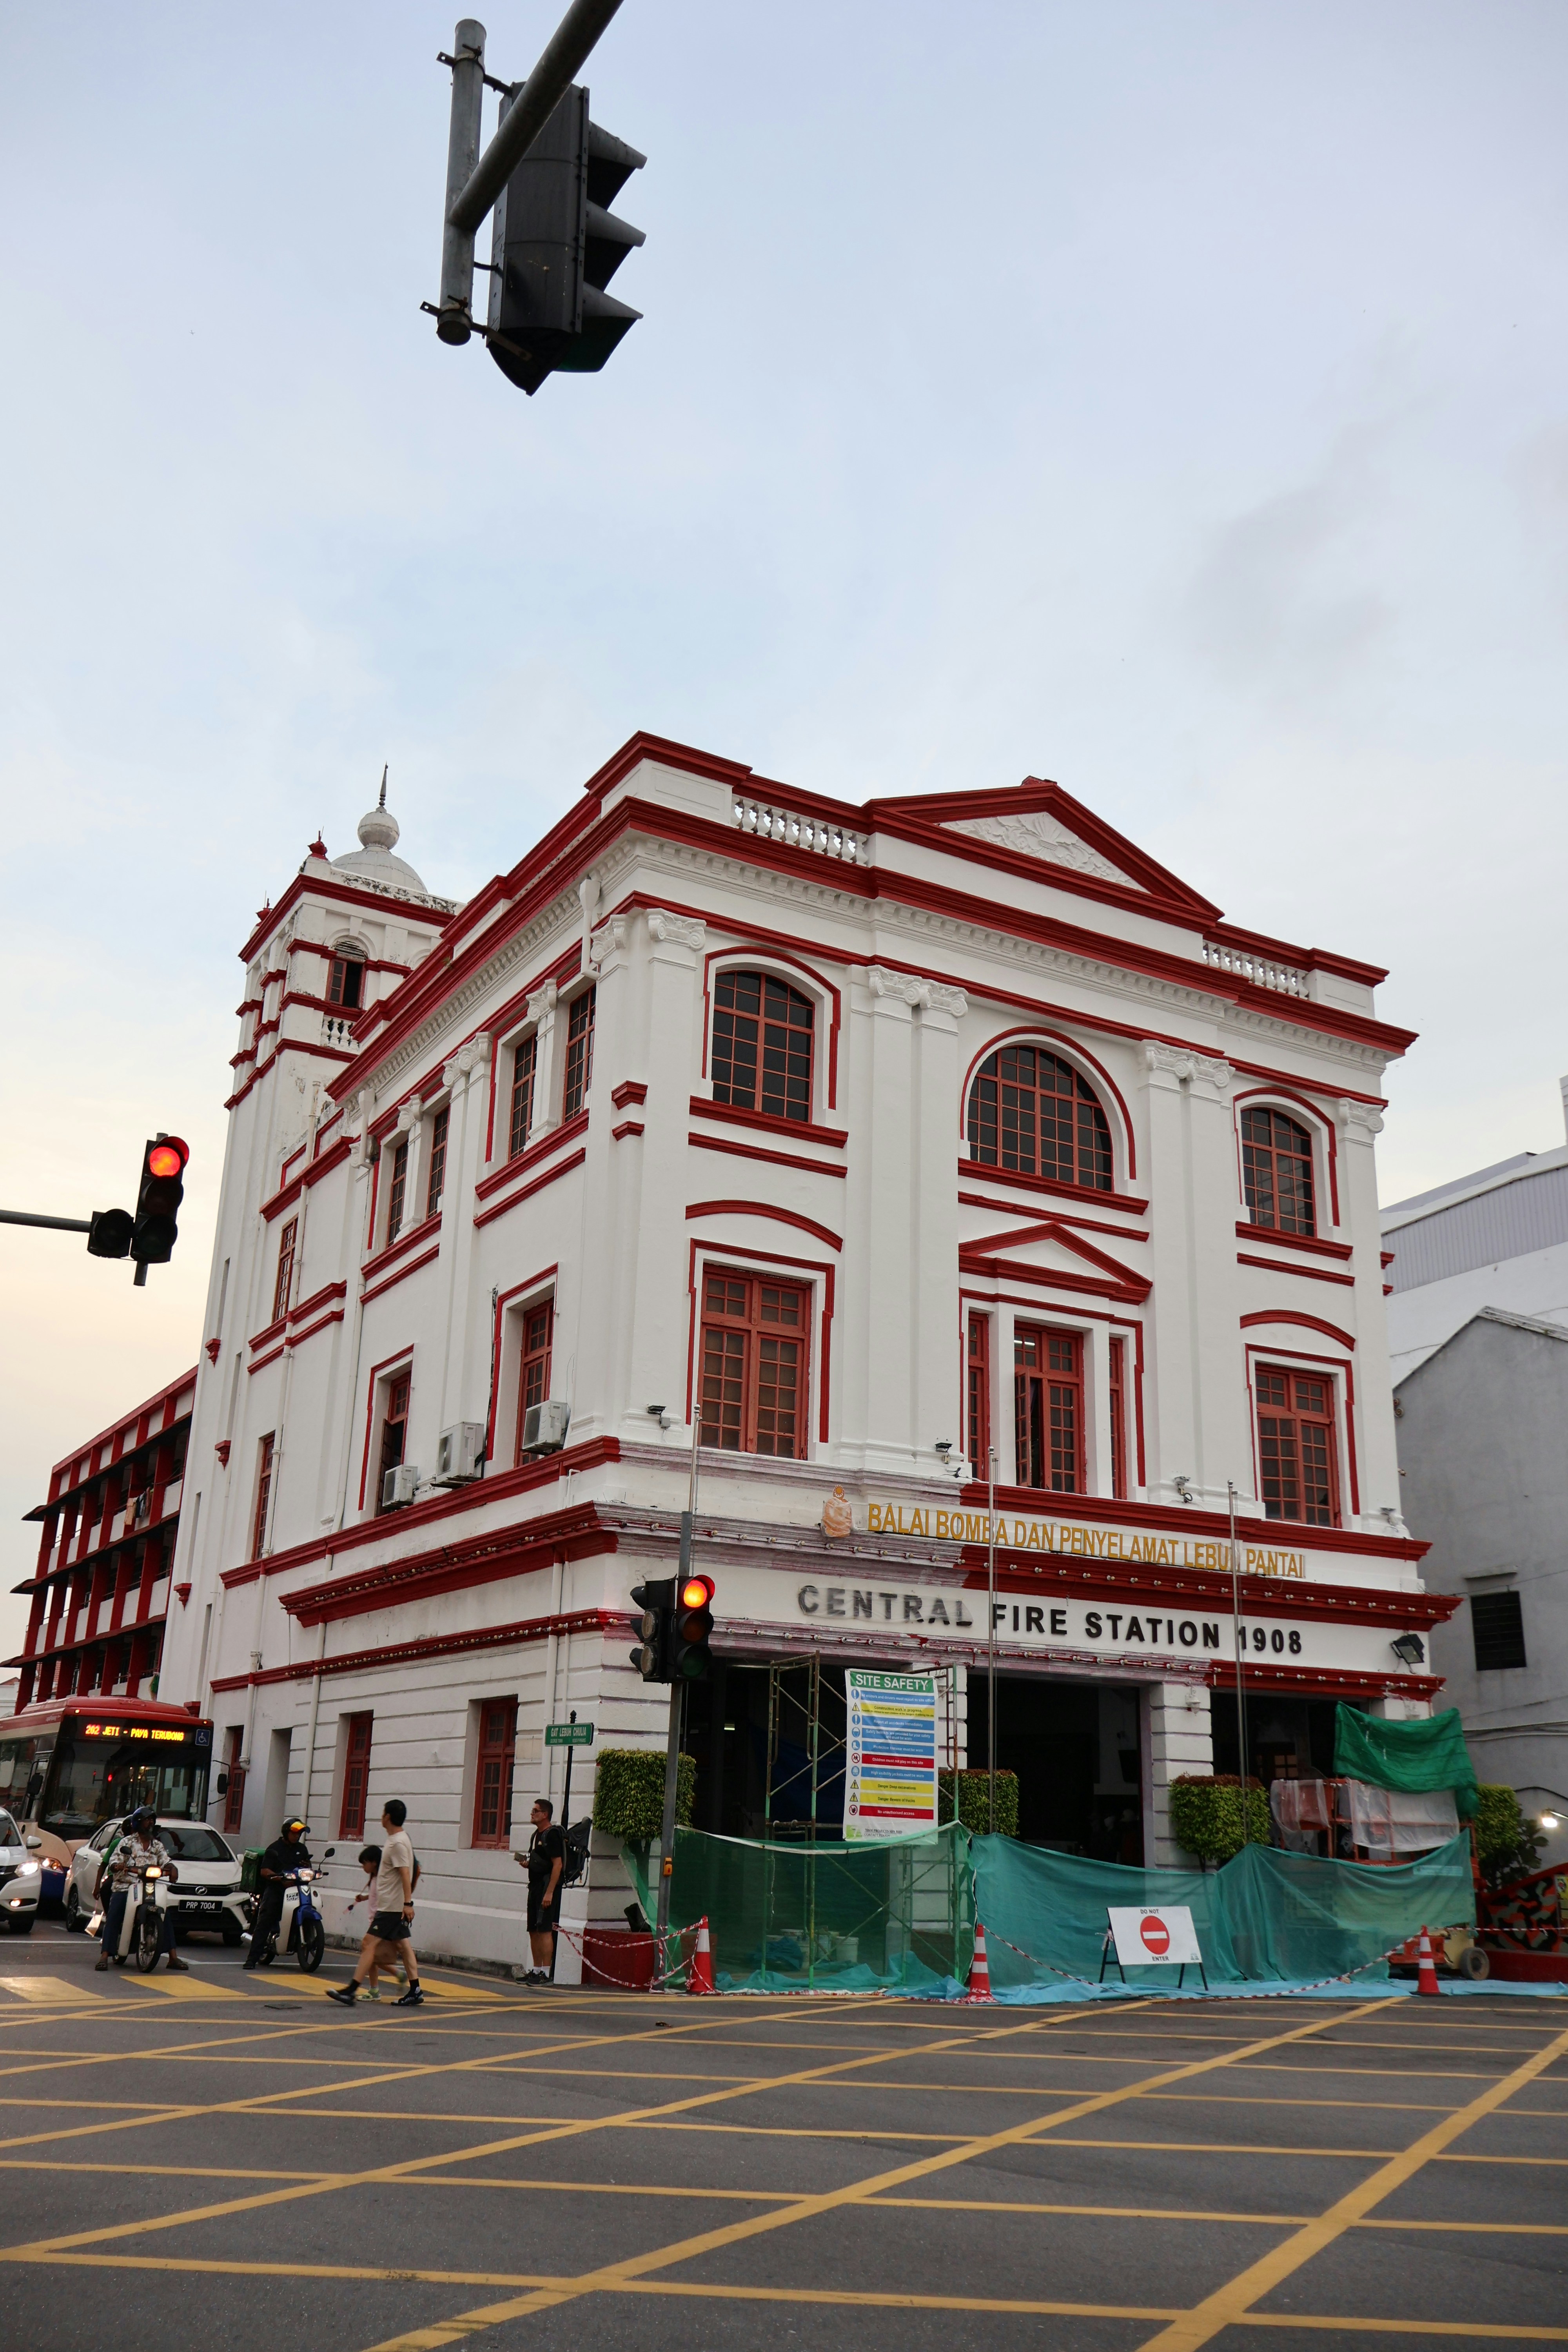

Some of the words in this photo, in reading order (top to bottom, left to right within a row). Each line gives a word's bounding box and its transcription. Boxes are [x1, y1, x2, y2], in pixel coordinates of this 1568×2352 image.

[868, 1503, 929, 1536] BALAI
[936, 1510, 1009, 1545] BOMBA
[1014, 1520, 1054, 1551] DAN
[1060, 1526, 1178, 1565] PENYELAMAT
[1247, 1548, 1303, 1578] PANTAI
[798, 1585, 973, 1626] CENTRAL
[993, 1603, 1067, 1635] FIRE
[1085, 1612, 1219, 1648] STATION
[1238, 1626, 1301, 1654] 1908
[856, 1674, 880, 1687] SITE
[884, 1677, 928, 1690] SAFETY
[85, 1724, 100, 1735] 202
[102, 1726, 120, 1737] JETI
[131, 1728, 148, 1739] PAYA
[151, 1730, 184, 1741] TERUBONG
[559, 1727, 572, 1737] LEBUH
[573, 1726, 586, 1737] CHULIA
